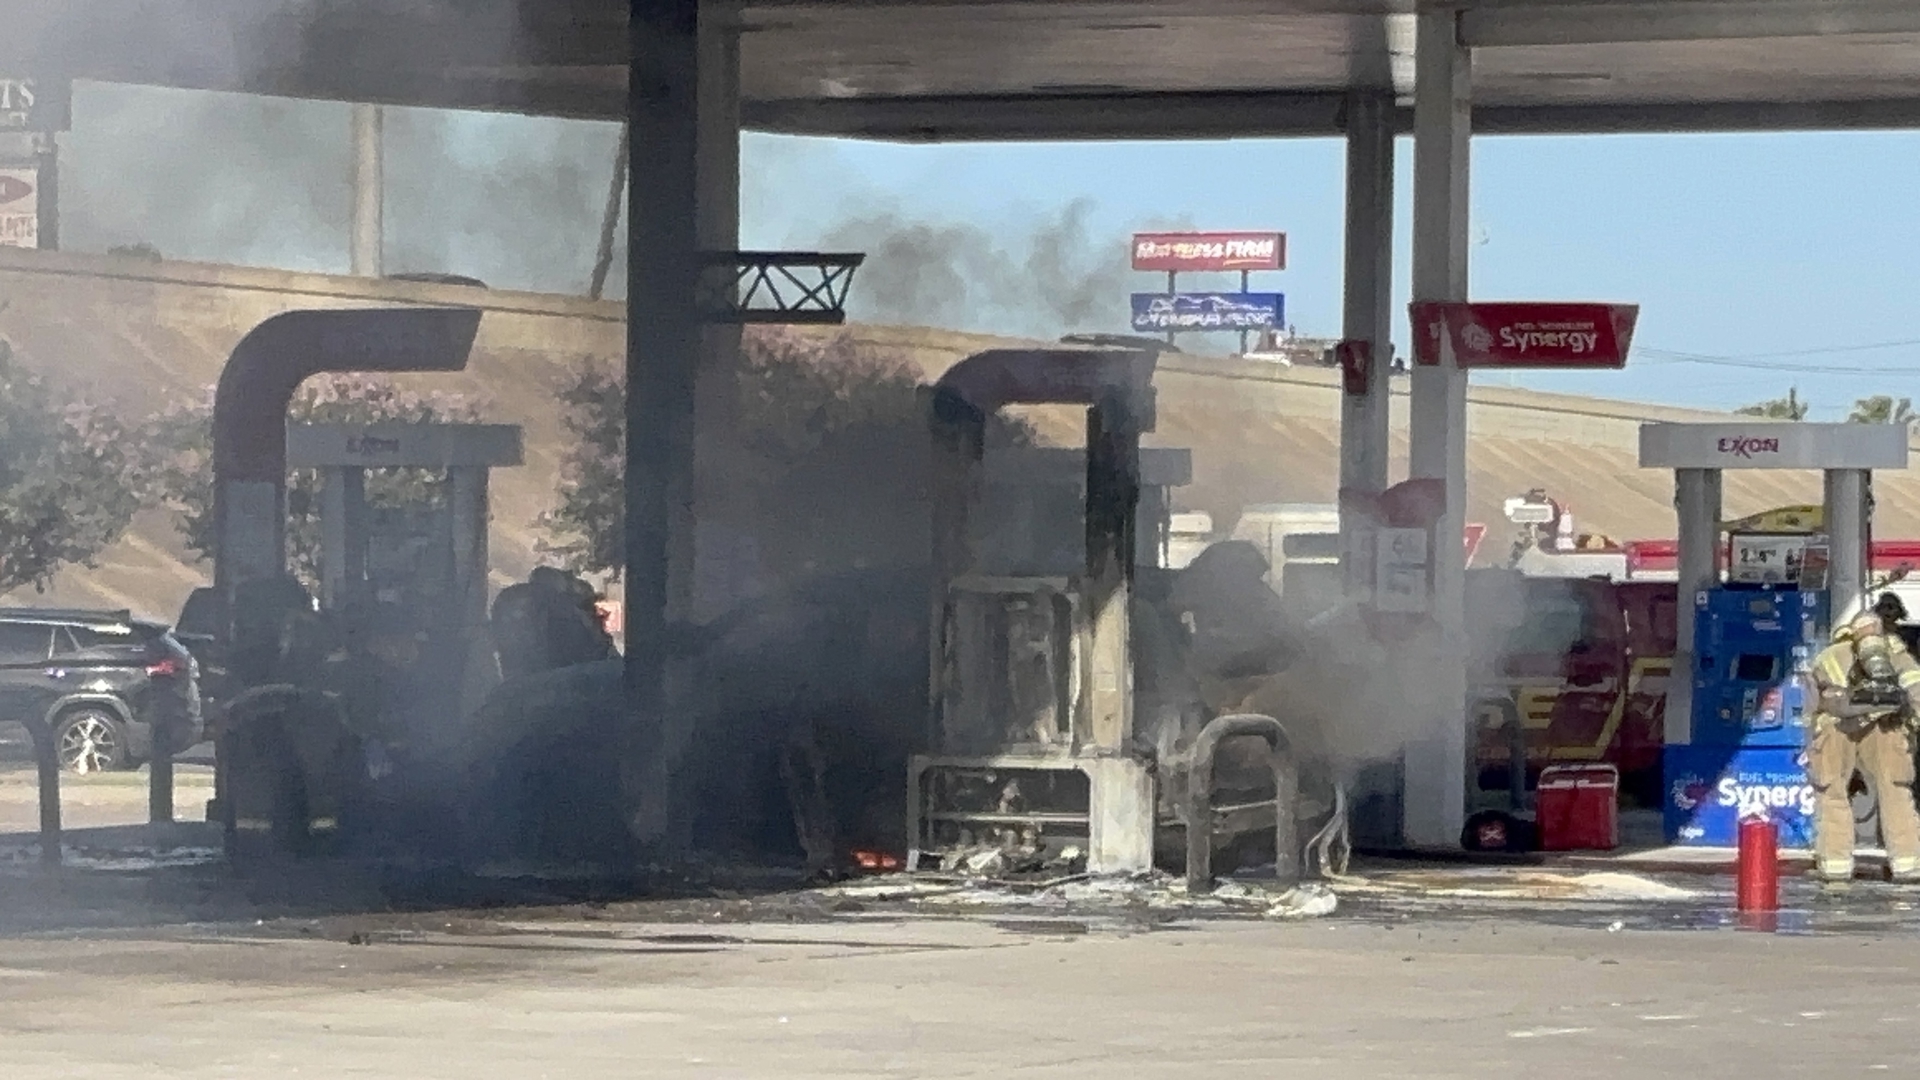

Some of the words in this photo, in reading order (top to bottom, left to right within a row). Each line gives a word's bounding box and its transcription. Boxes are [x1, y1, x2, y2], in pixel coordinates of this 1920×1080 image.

[1499, 326, 1598, 354] Synergy
[1717, 434, 1779, 459] EXXON
[1718, 777, 1816, 816] Synerg
